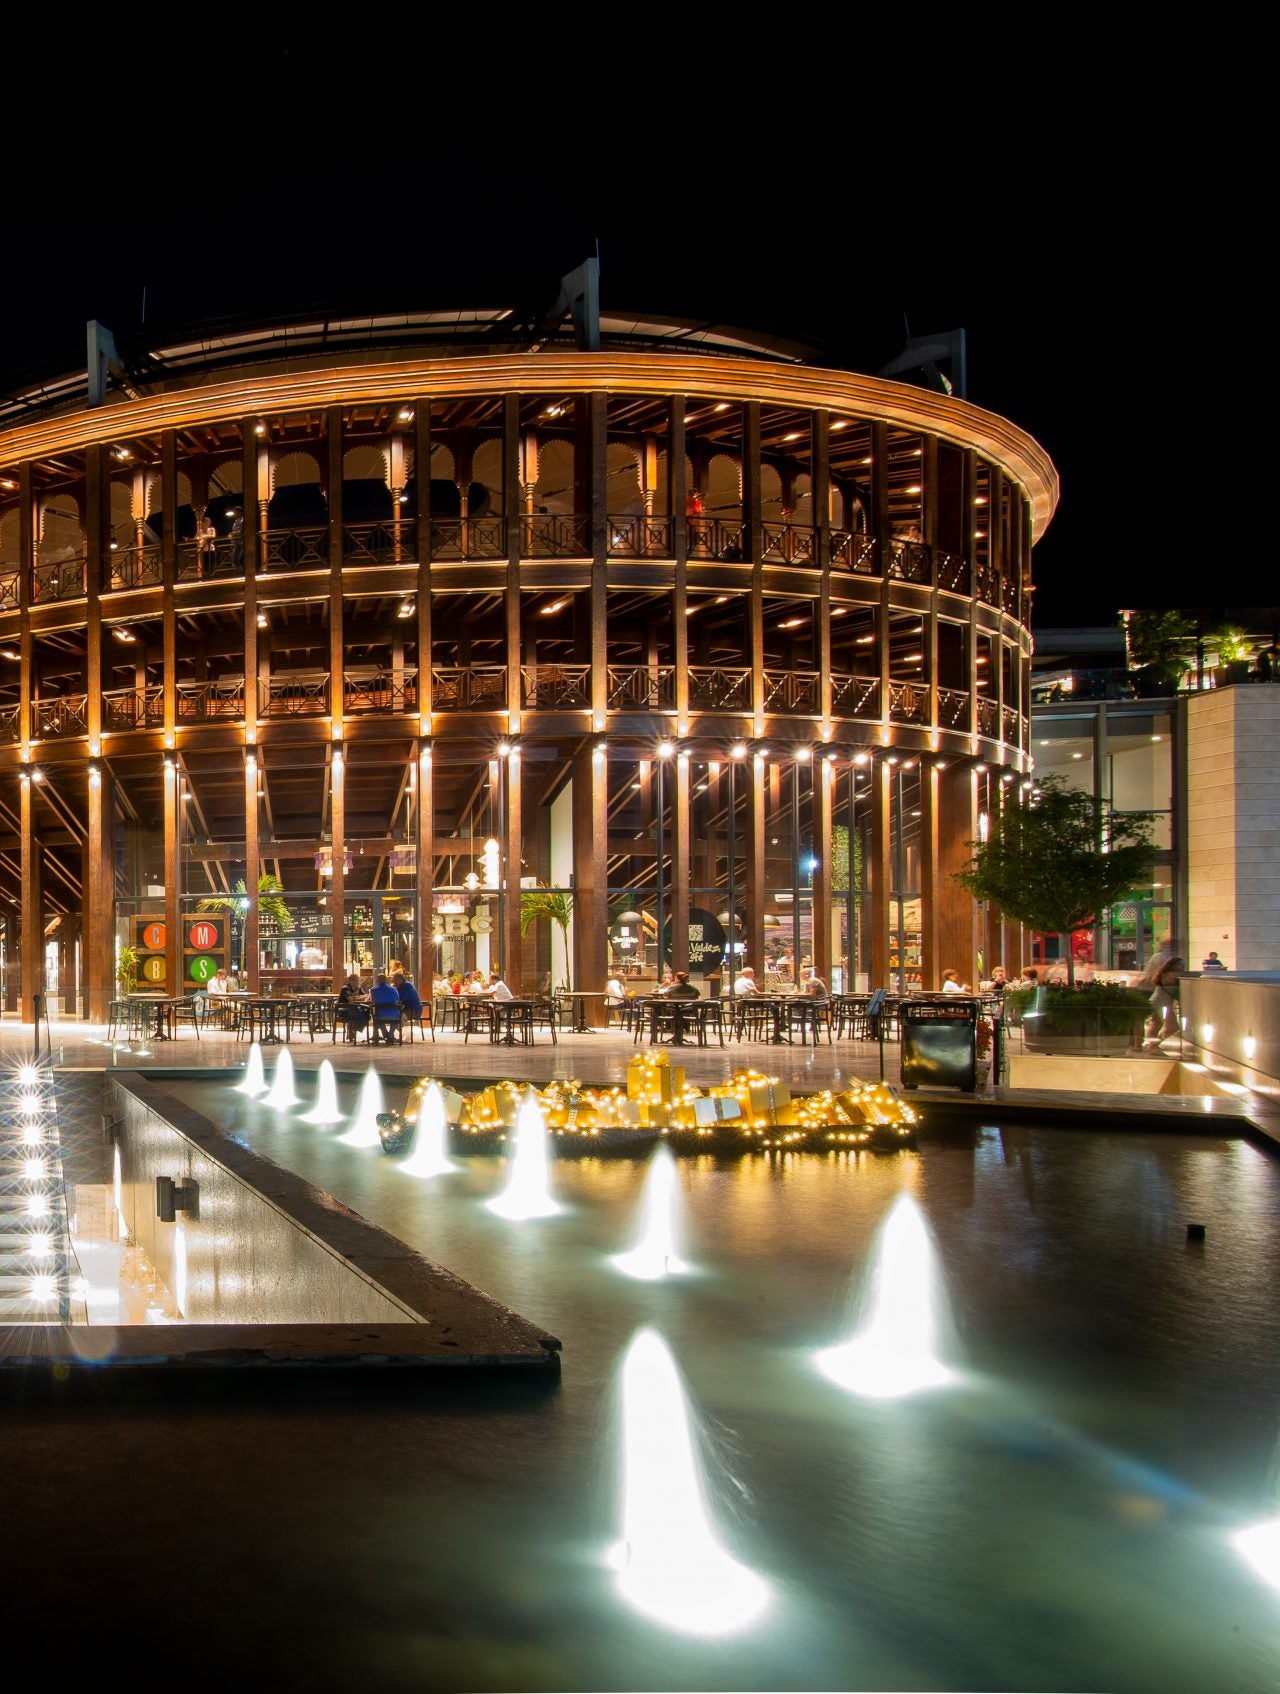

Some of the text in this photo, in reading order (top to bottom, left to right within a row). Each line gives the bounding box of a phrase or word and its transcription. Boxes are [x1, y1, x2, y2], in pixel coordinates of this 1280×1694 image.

[153, 927, 160, 945] C
[197, 927, 209, 945] M
[152, 960, 160, 979] B
[199, 959, 208, 979] S
